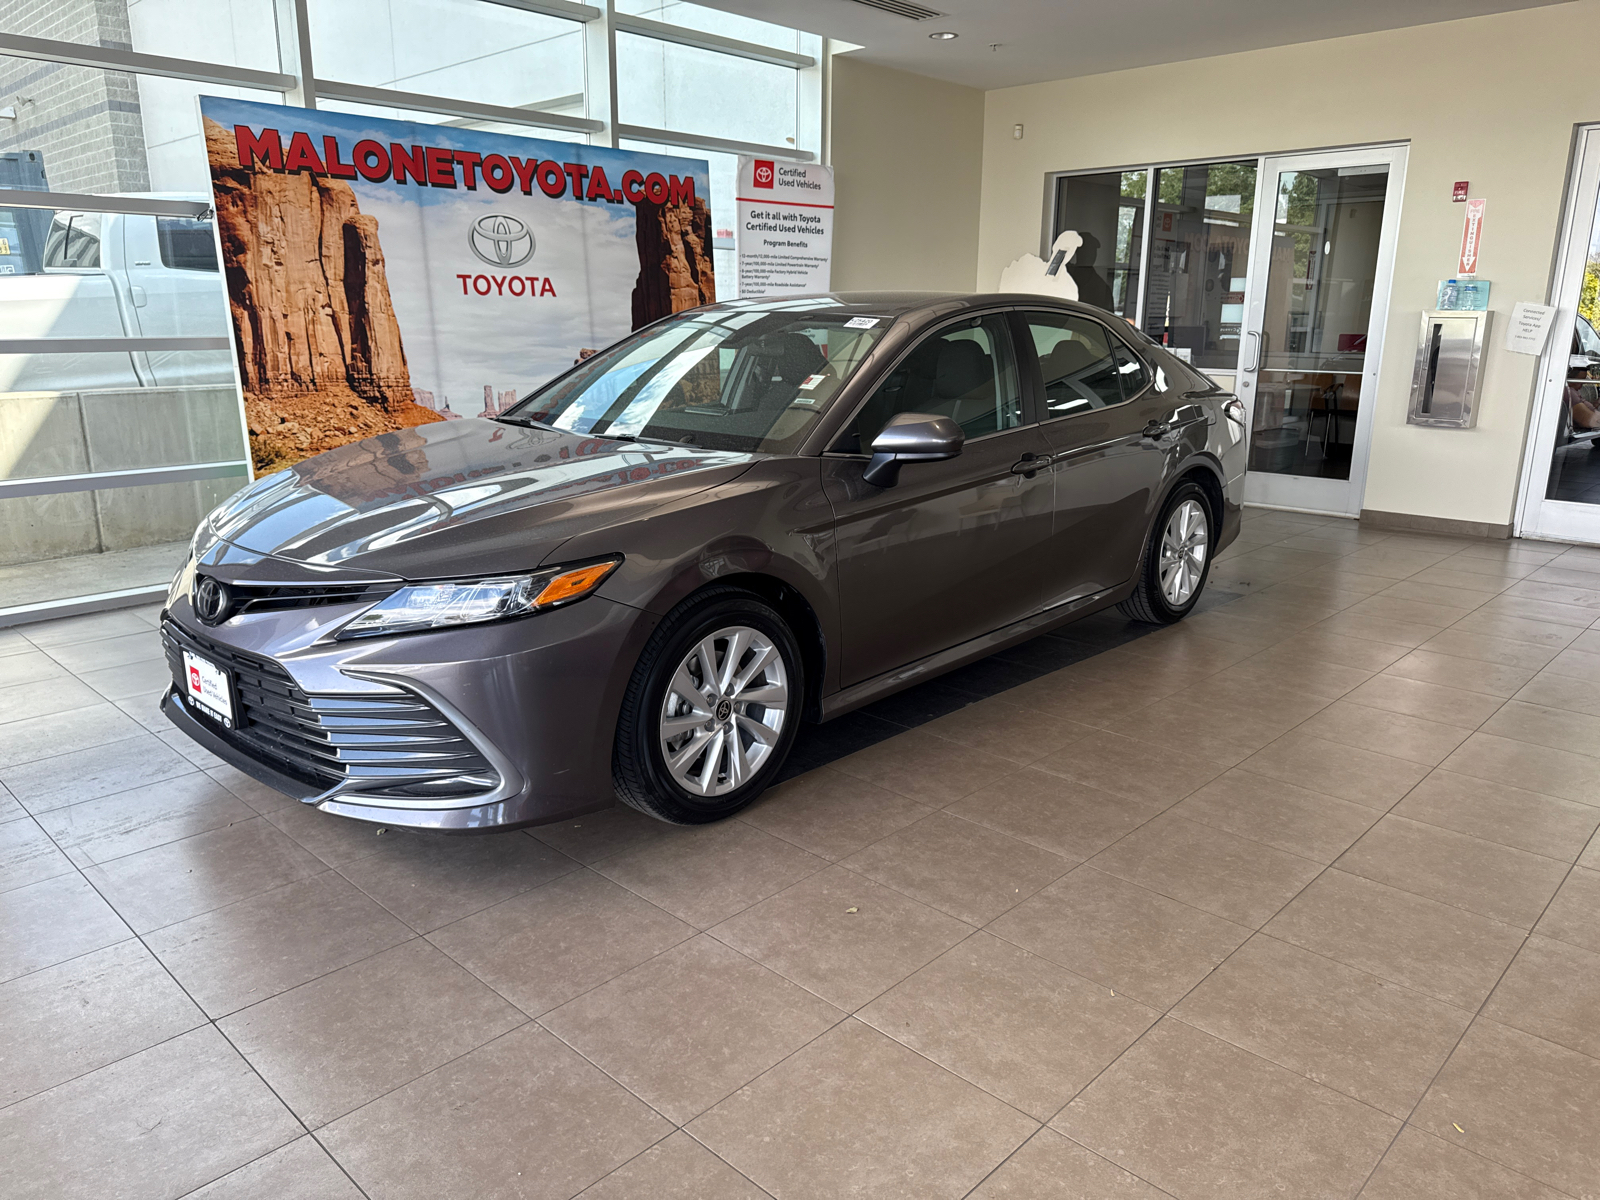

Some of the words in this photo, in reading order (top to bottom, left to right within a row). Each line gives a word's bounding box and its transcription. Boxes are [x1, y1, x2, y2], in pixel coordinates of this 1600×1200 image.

[233, 124, 696, 208] MALONETOYOTA.COM
[778, 167, 806, 178] Certified
[778, 178, 794, 187] Used
[796, 180, 822, 190] Vehicles
[750, 210, 764, 219] Get
[764, 210, 770, 220] it
[772, 212, 780, 220] all
[782, 212, 798, 222] with
[799, 214, 821, 224] Toyota
[746, 222, 778, 232] Certified
[778, 224, 796, 233] Used
[797, 225, 824, 235] Vehicles
[764, 239, 786, 248] Program
[1466, 214, 1476, 266] EXTINGUISHER
[456, 274, 557, 298] TOYOTA
[202, 676, 218, 690] Certified
[203, 686, 212, 697] Used
[212, 692, 228, 706] Vehicles
